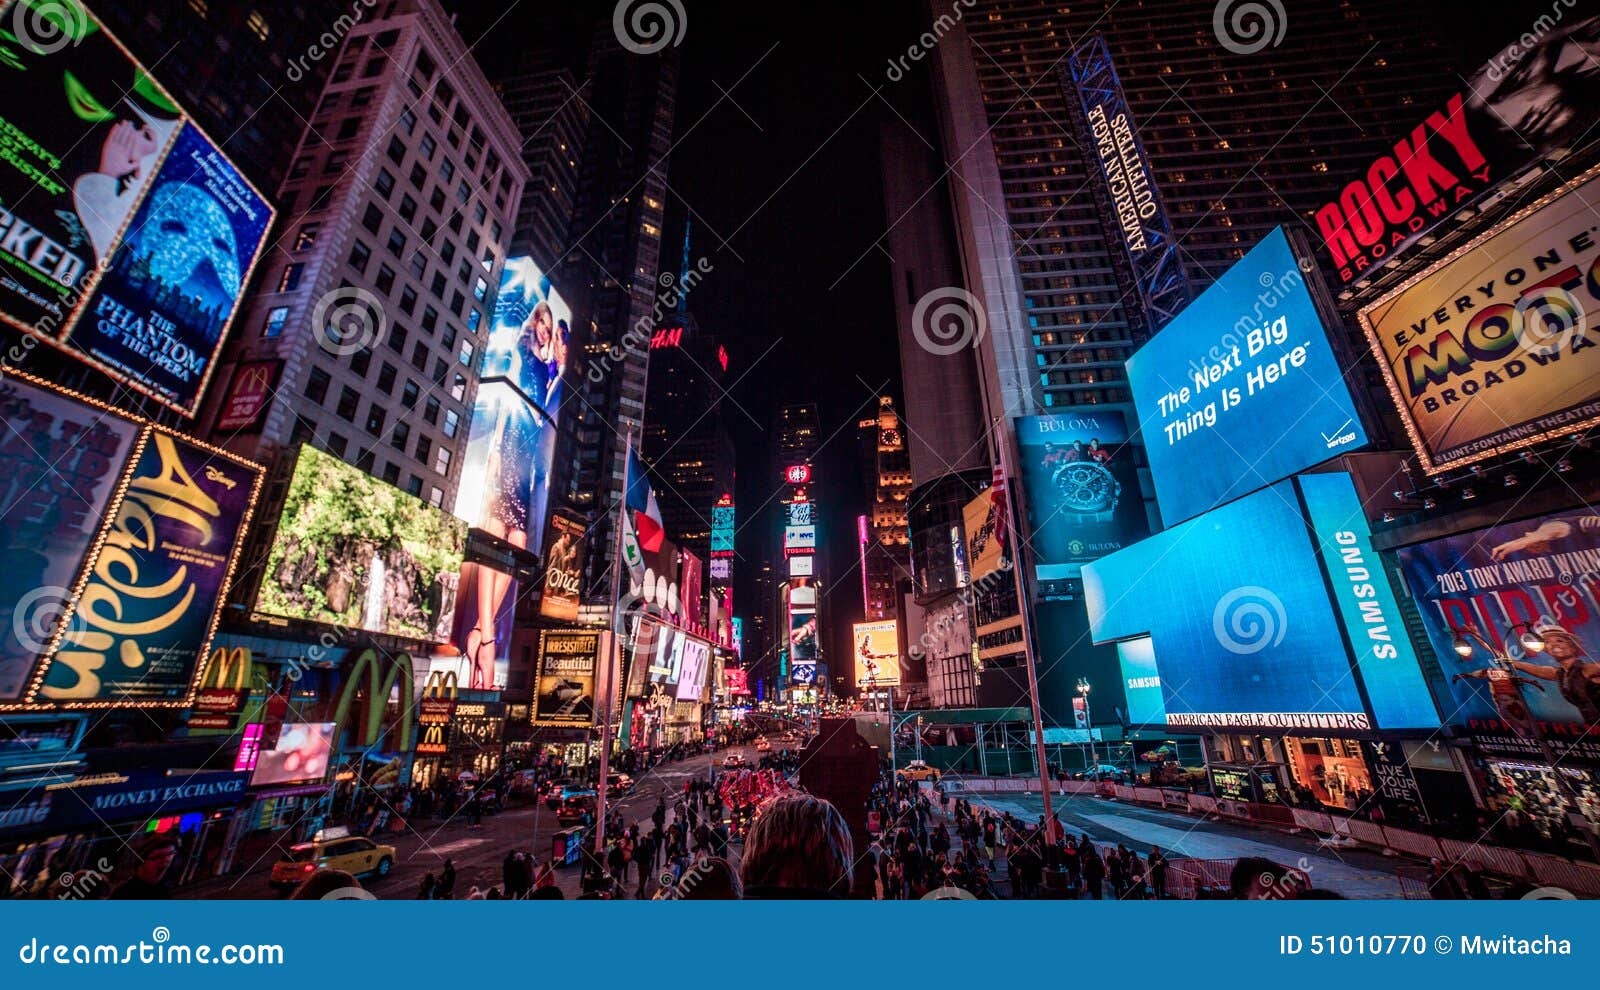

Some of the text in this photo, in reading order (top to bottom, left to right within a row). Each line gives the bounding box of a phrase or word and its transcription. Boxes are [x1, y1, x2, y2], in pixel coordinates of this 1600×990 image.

[1088, 104, 1147, 251] AMERICAN EAGLE
[1111, 113, 1157, 220] OUTFITTERS
[1315, 92, 1487, 269] ROCKY
[1340, 166, 1490, 282] BROADWAY
[95, 294, 206, 376] PHANTOM
[149, 310, 177, 335] THE
[97, 319, 121, 338] OF
[121, 331, 152, 357] THE
[149, 350, 190, 382] OPERA
[1157, 315, 1289, 418] The Next Big
[1422, 326, 1600, 413] BROADWA
[1039, 418, 1099, 433] BULOVA
[1164, 402, 1217, 445] Thing
[1222, 388, 1242, 411] Is
[1327, 431, 1356, 448] verizon
[1442, 423, 1537, 462] LUNT-FONTANNE
[1437, 572, 1467, 594] 2013
[1465, 567, 1504, 590] TONY
[1503, 557, 1555, 584] AWARD
[1336, 531, 1397, 660] SAMSUNG
[545, 656, 593, 670] Beautiful
[455, 704, 486, 716] EXPRESS
[1168, 713, 1370, 729] AMERICAN EAGLE OUTFITTERS
[1375, 764, 1405, 777] LIVE
[1378, 776, 1417, 790] YOUR
[95, 789, 160, 809] MONEY
[162, 779, 243, 800] EXCHANGE
[1382, 788, 1414, 801] LIFE
